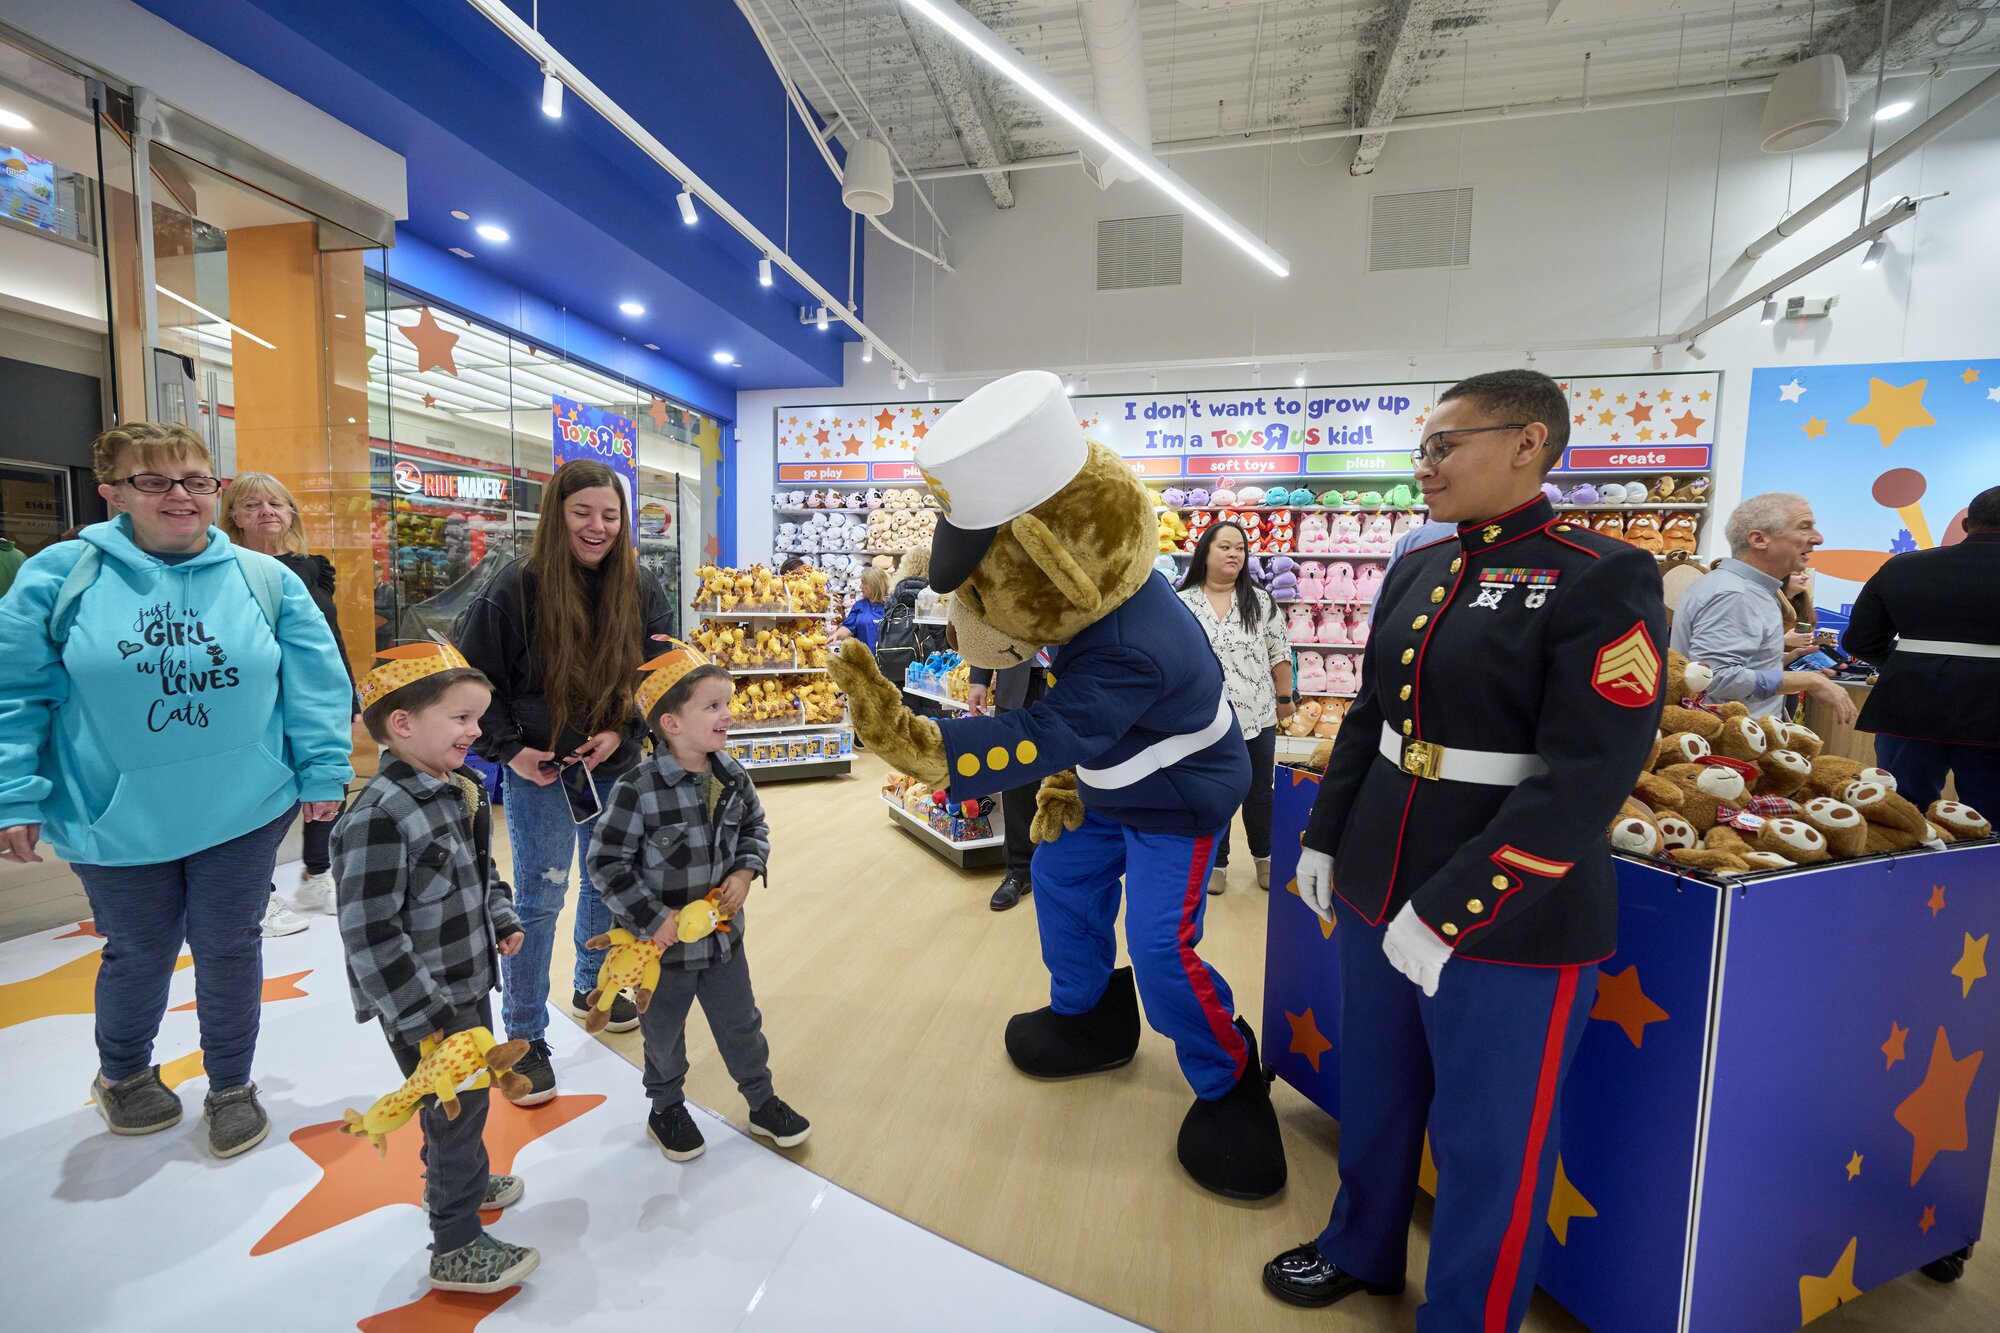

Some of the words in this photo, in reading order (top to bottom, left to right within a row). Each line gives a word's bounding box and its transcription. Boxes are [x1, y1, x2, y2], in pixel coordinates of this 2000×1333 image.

[1124, 401, 1137, 421] I
[1143, 398, 1202, 420] don't
[1208, 397, 1267, 417] want
[1273, 396, 1302, 415] to
[1308, 398, 1371, 420] grow
[1377, 395, 1410, 415] up
[1145, 429, 1184, 449] I'm
[1189, 434, 1203, 448] a
[1328, 425, 1374, 446] kid!
[1210, 459, 1241, 472] soft
[1243, 459, 1276, 473] toys
[1345, 456, 1386, 471] plush
[1608, 451, 1666, 465] create
[803, 469, 818, 480] go
[819, 467, 843, 479] play
[903, 466, 922, 479] plu
[424, 473, 508, 500] RIDEMAKERZ
[133, 601, 176, 632] just
[144, 621, 215, 647] GIRL
[137, 645, 192, 679] who
[162, 667, 240, 696] LOVES
[147, 699, 213, 733] Cats
